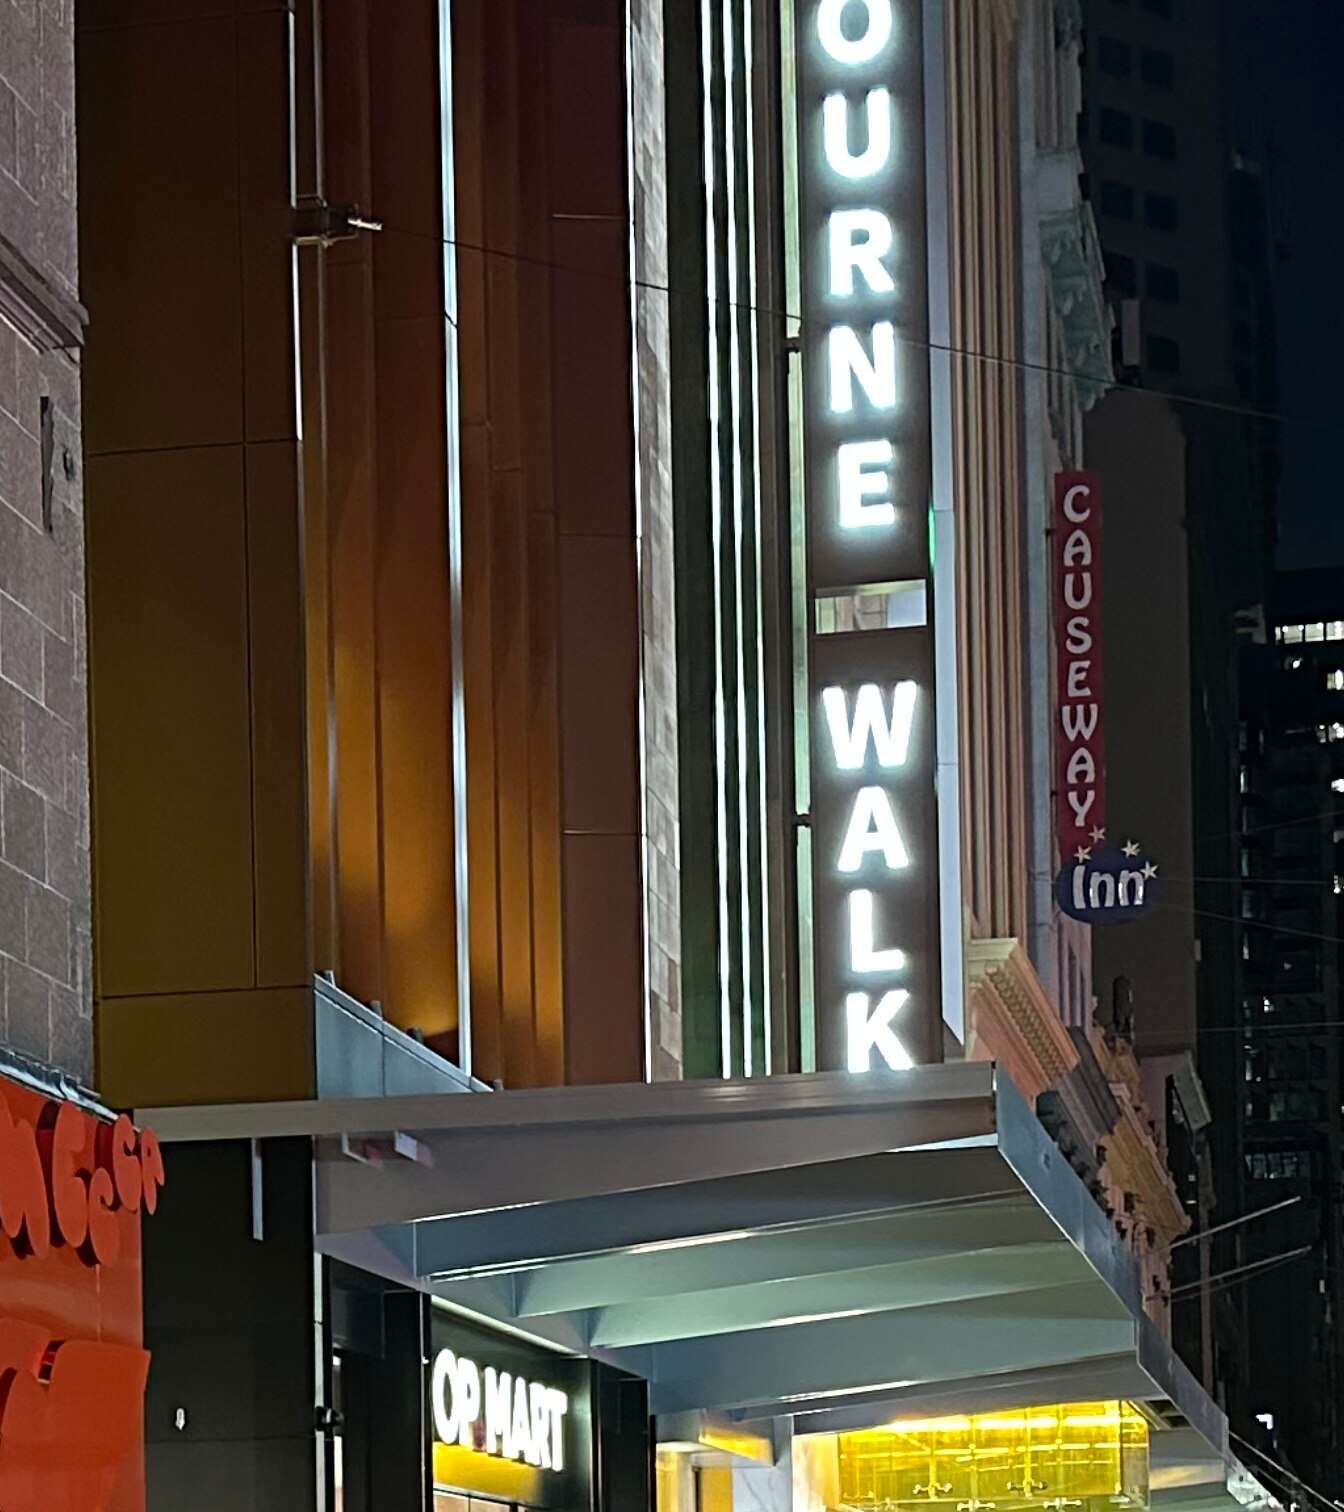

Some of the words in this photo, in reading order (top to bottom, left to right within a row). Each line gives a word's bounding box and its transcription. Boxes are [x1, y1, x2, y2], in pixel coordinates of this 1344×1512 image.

[1061, 484, 1099, 828] CAUSEWAY
[820, 680, 918, 1073] WALK
[1071, 863, 1145, 909] Inn
[484, 1366, 568, 1472] MART
